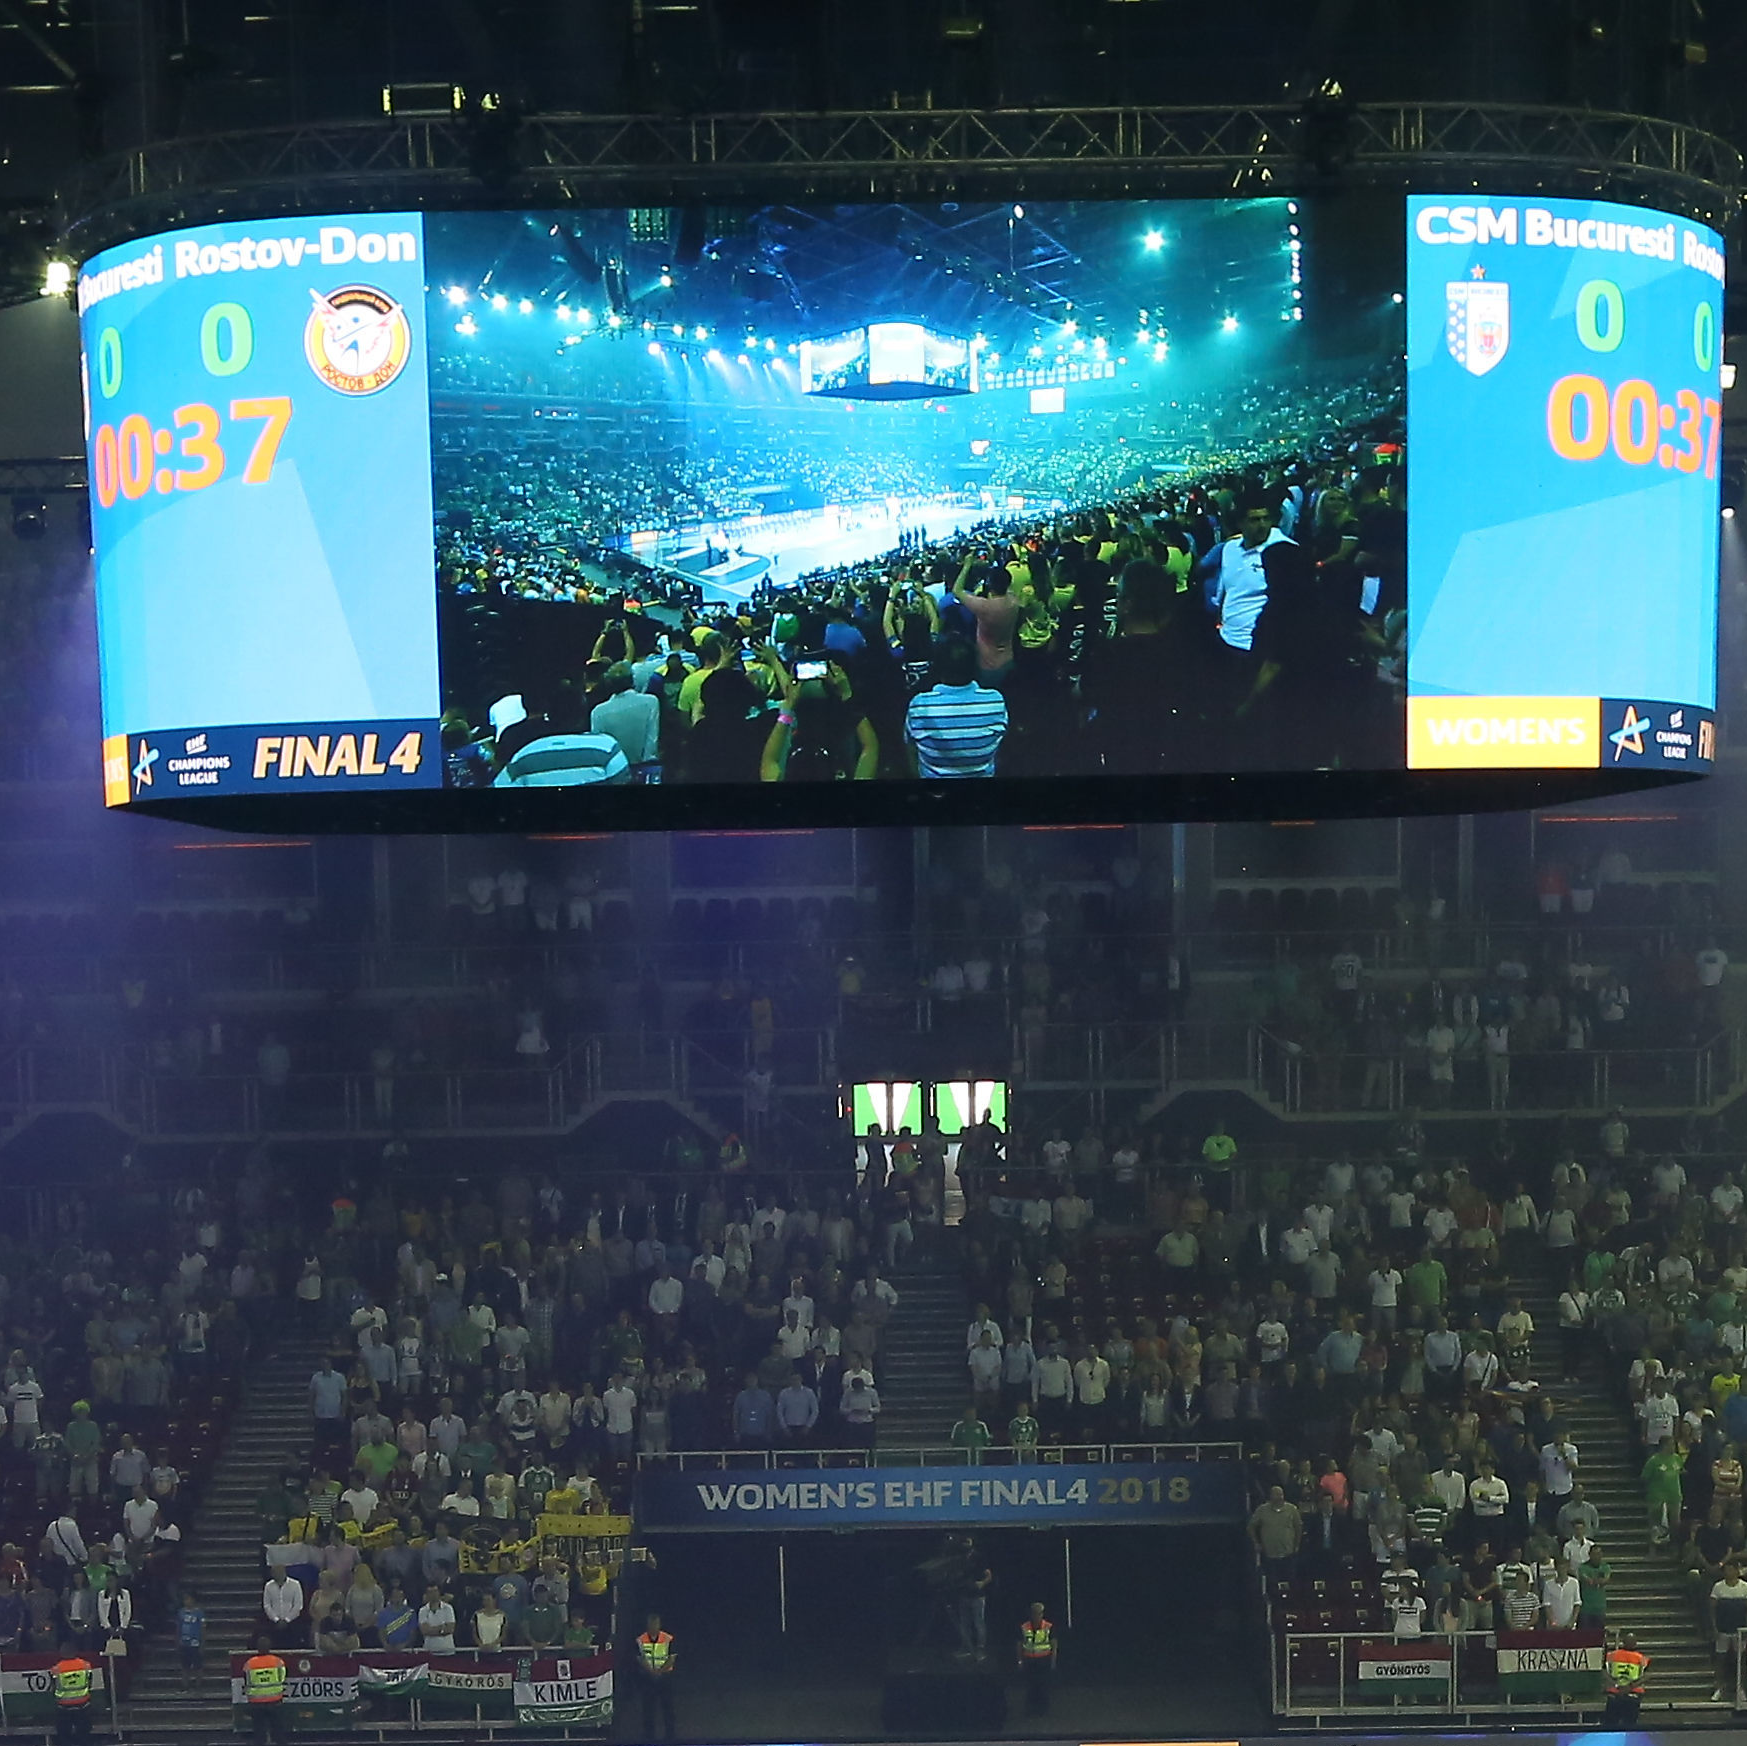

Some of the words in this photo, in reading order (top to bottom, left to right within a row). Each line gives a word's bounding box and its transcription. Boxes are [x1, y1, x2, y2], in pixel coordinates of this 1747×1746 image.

[1416, 206, 1518, 245] CSM
[1524, 208, 1675, 260] Bucuresti
[174, 226, 417, 279] Rostov-Don
[1576, 279, 1625, 352] 0
[1694, 301, 1714, 372] 0
[99, 326, 123, 399] 0
[200, 302, 254, 376] 0
[1547, 375, 1722, 480] 00:37
[95, 397, 293, 508] 00:37
[185, 734, 208, 752] EHF
[1426, 717, 1586, 745] WOMEN'S
[168, 756, 231, 772] CHAMPIONS
[179, 771, 219, 786] LEAGUE
[696, 1482, 876, 1512] WOMEN'S
[884, 1480, 953, 1509] EHF
[1097, 1476, 1192, 1504] 2018
[1517, 1648, 1589, 1672] KRASZNA
[535, 1681, 597, 1703] KIMLE
